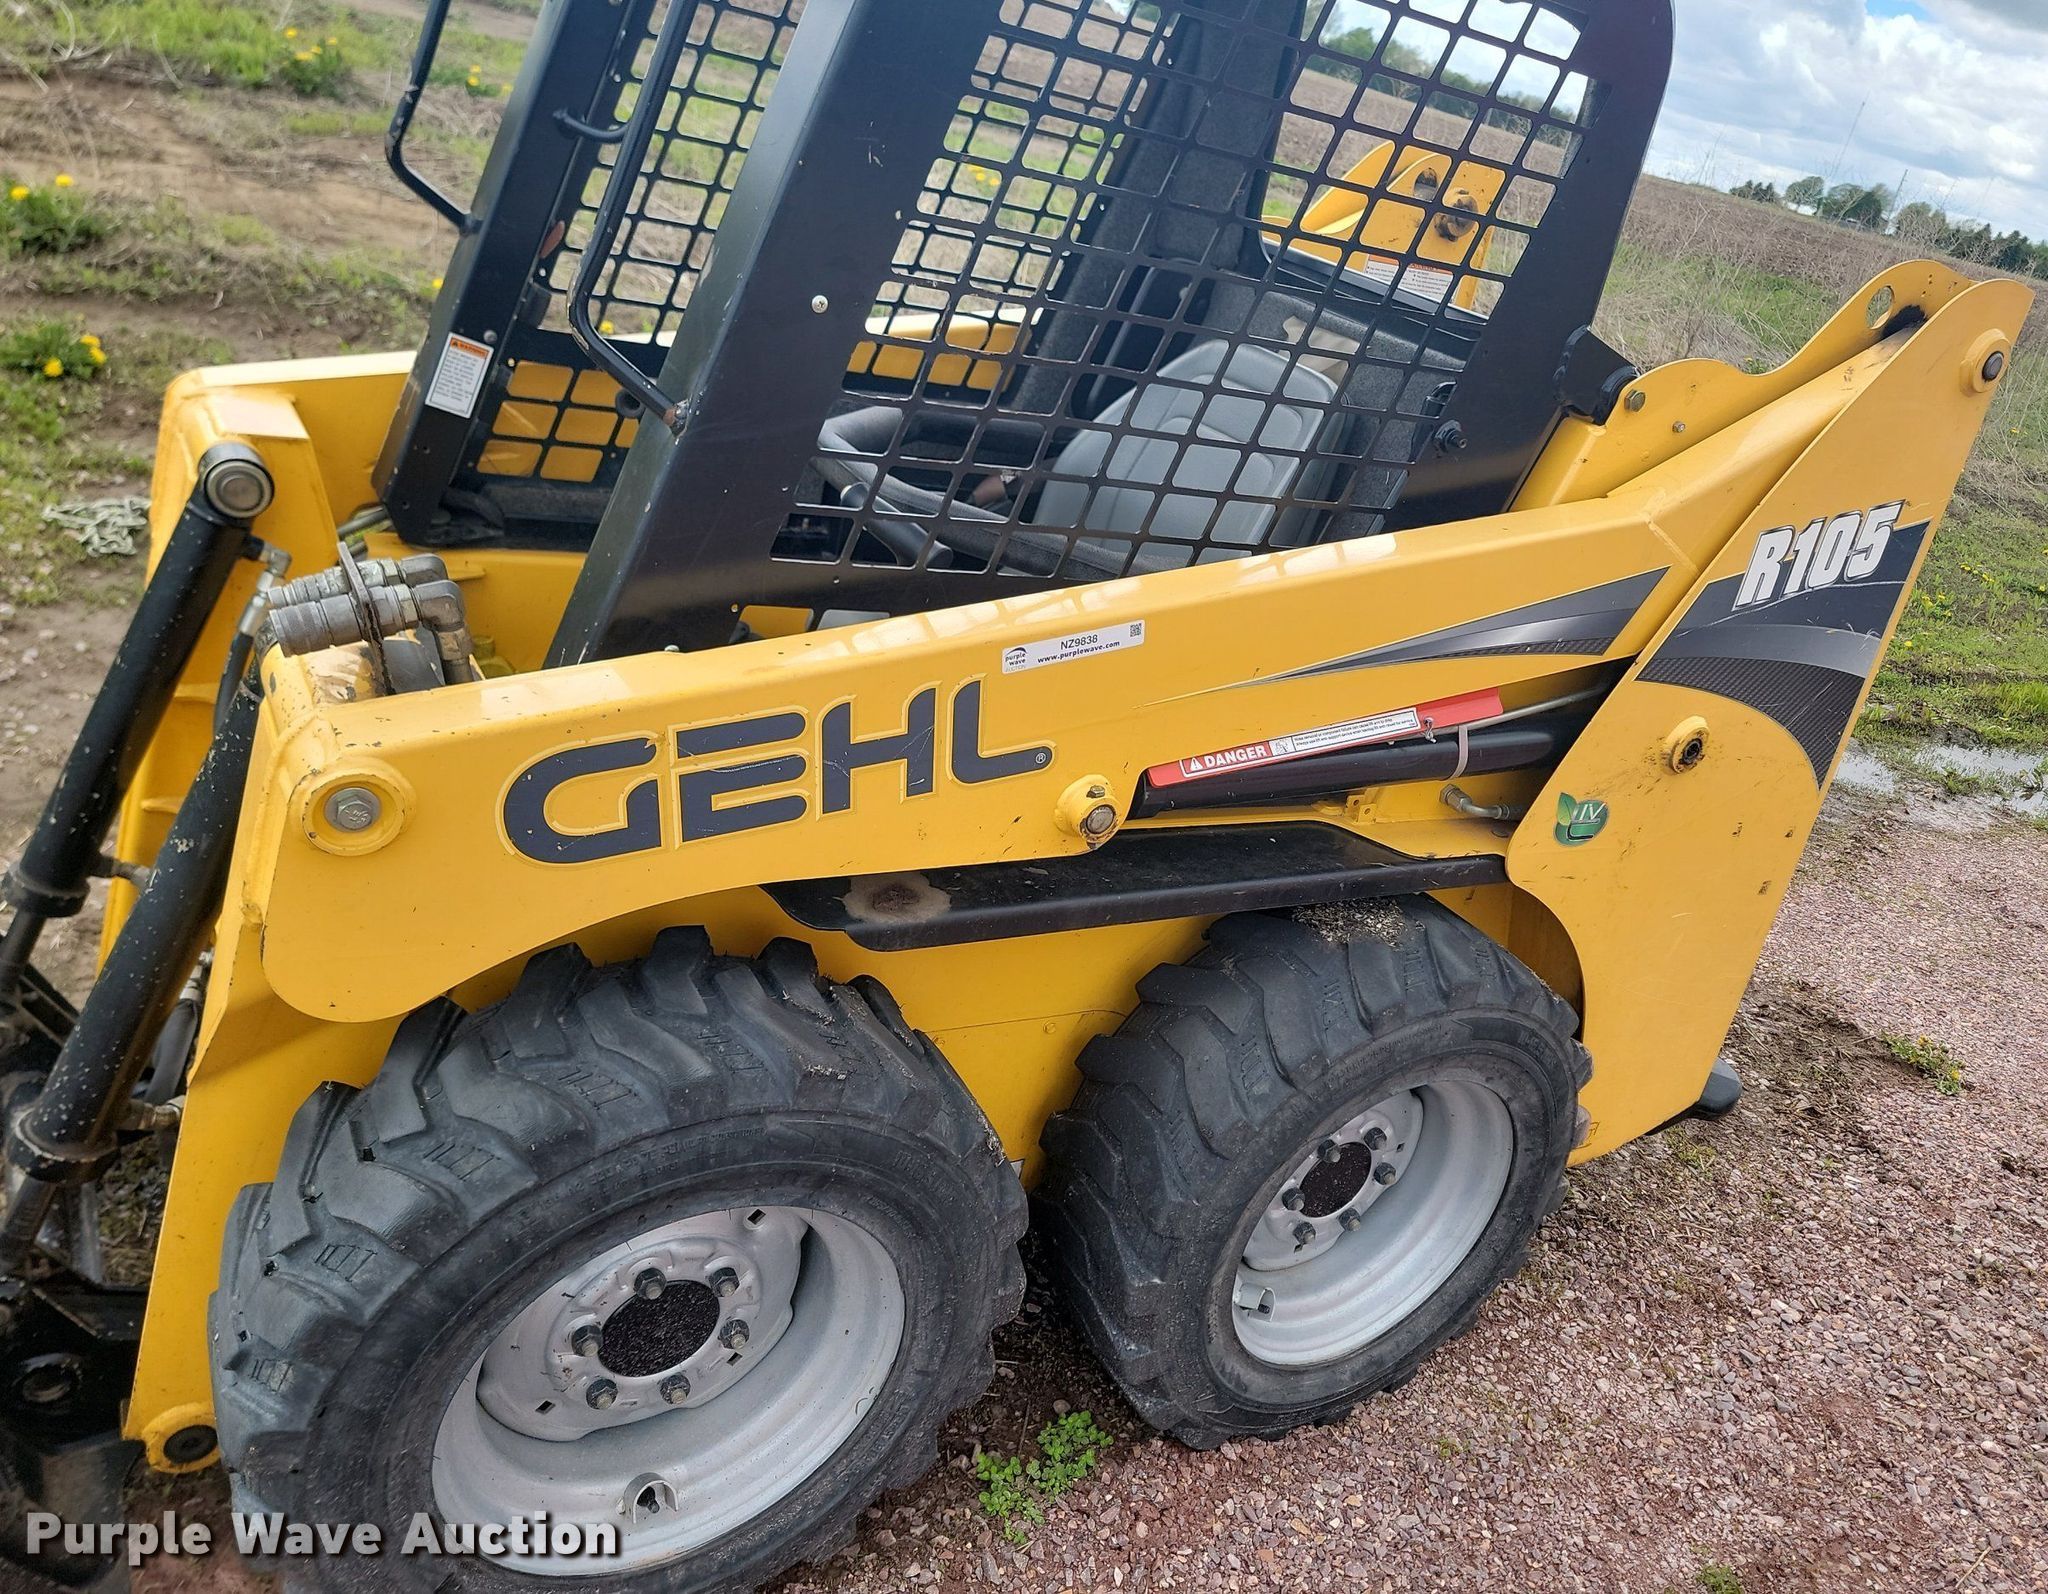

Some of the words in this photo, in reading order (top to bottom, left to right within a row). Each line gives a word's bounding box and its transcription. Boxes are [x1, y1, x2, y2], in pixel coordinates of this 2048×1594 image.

[1732, 500, 1905, 611] R105
[1037, 640, 1120, 663] www.purplewave.com
[1060, 634, 1098, 650] NZ9838
[1005, 652, 1026, 662] purple
[1203, 745, 1267, 768] DANGER
[503, 680, 1053, 864] GEHL
